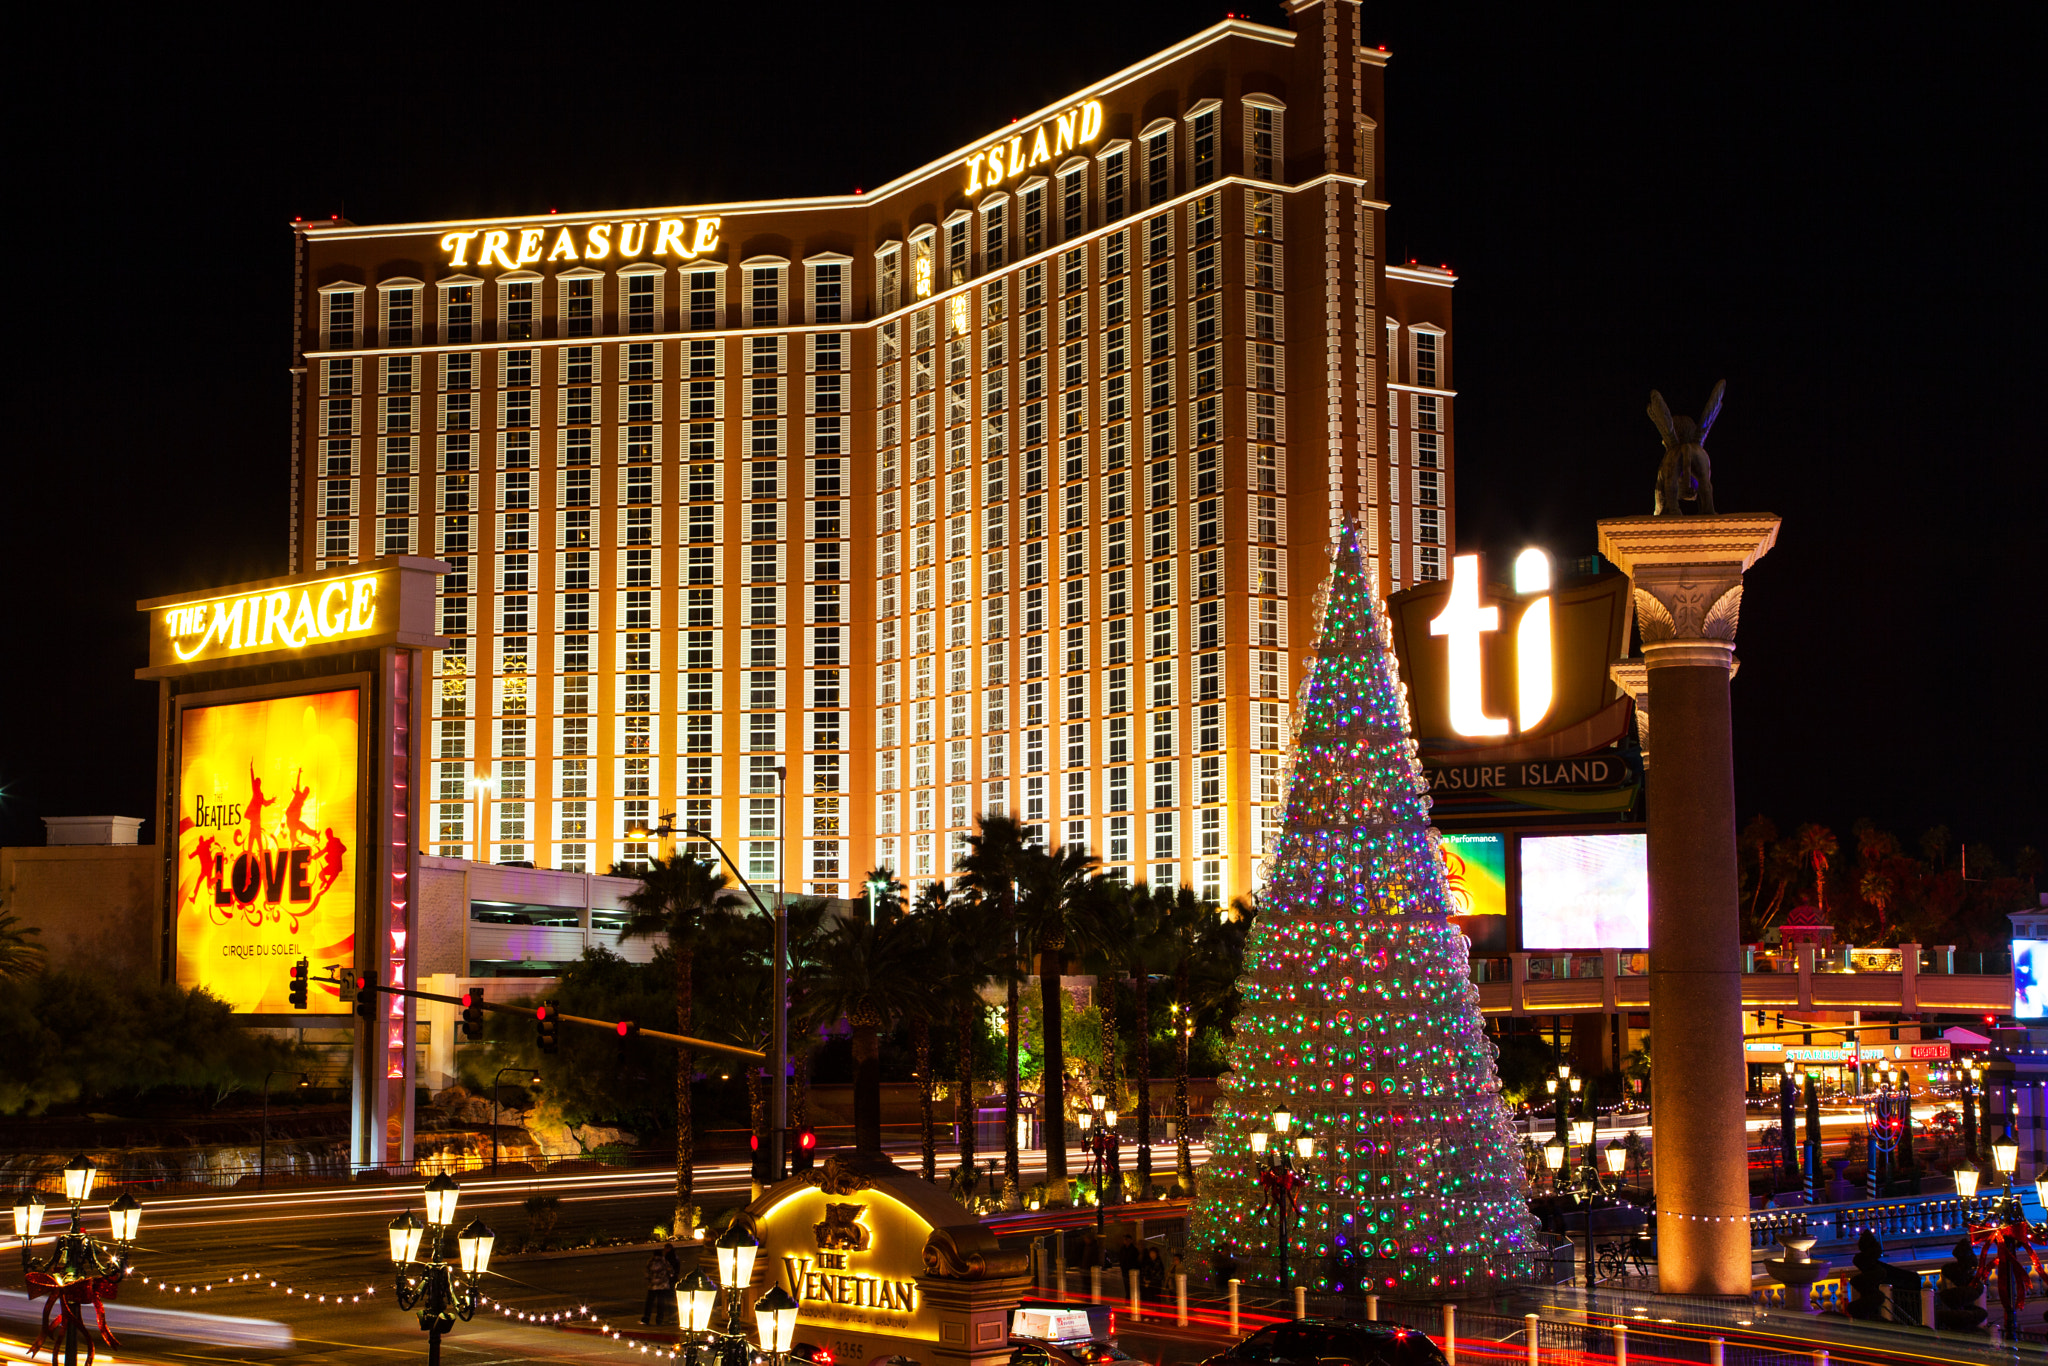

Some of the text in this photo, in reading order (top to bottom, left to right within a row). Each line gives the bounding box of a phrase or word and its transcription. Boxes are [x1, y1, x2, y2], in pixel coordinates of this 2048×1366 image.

[441, 99, 1102, 269] TREASURE ISLAND
[166, 577, 378, 660] THE MIRAGE
[1430, 547, 1553, 737] ti
[1423, 761, 1608, 790] EASURE ISLAND
[195, 794, 242, 830] BEATLES
[214, 793, 223, 802] THE
[1450, 834, 1499, 844] Performance.
[214, 847, 312, 907] LOVE
[222, 943, 302, 959] CIRQUE DU SOLEIL
[1786, 1049, 1884, 1061] STARBUCK COFFEE
[816, 1252, 847, 1270] THE
[781, 1256, 915, 1312] VENETIAN
[835, 1341, 863, 1360] 3355
